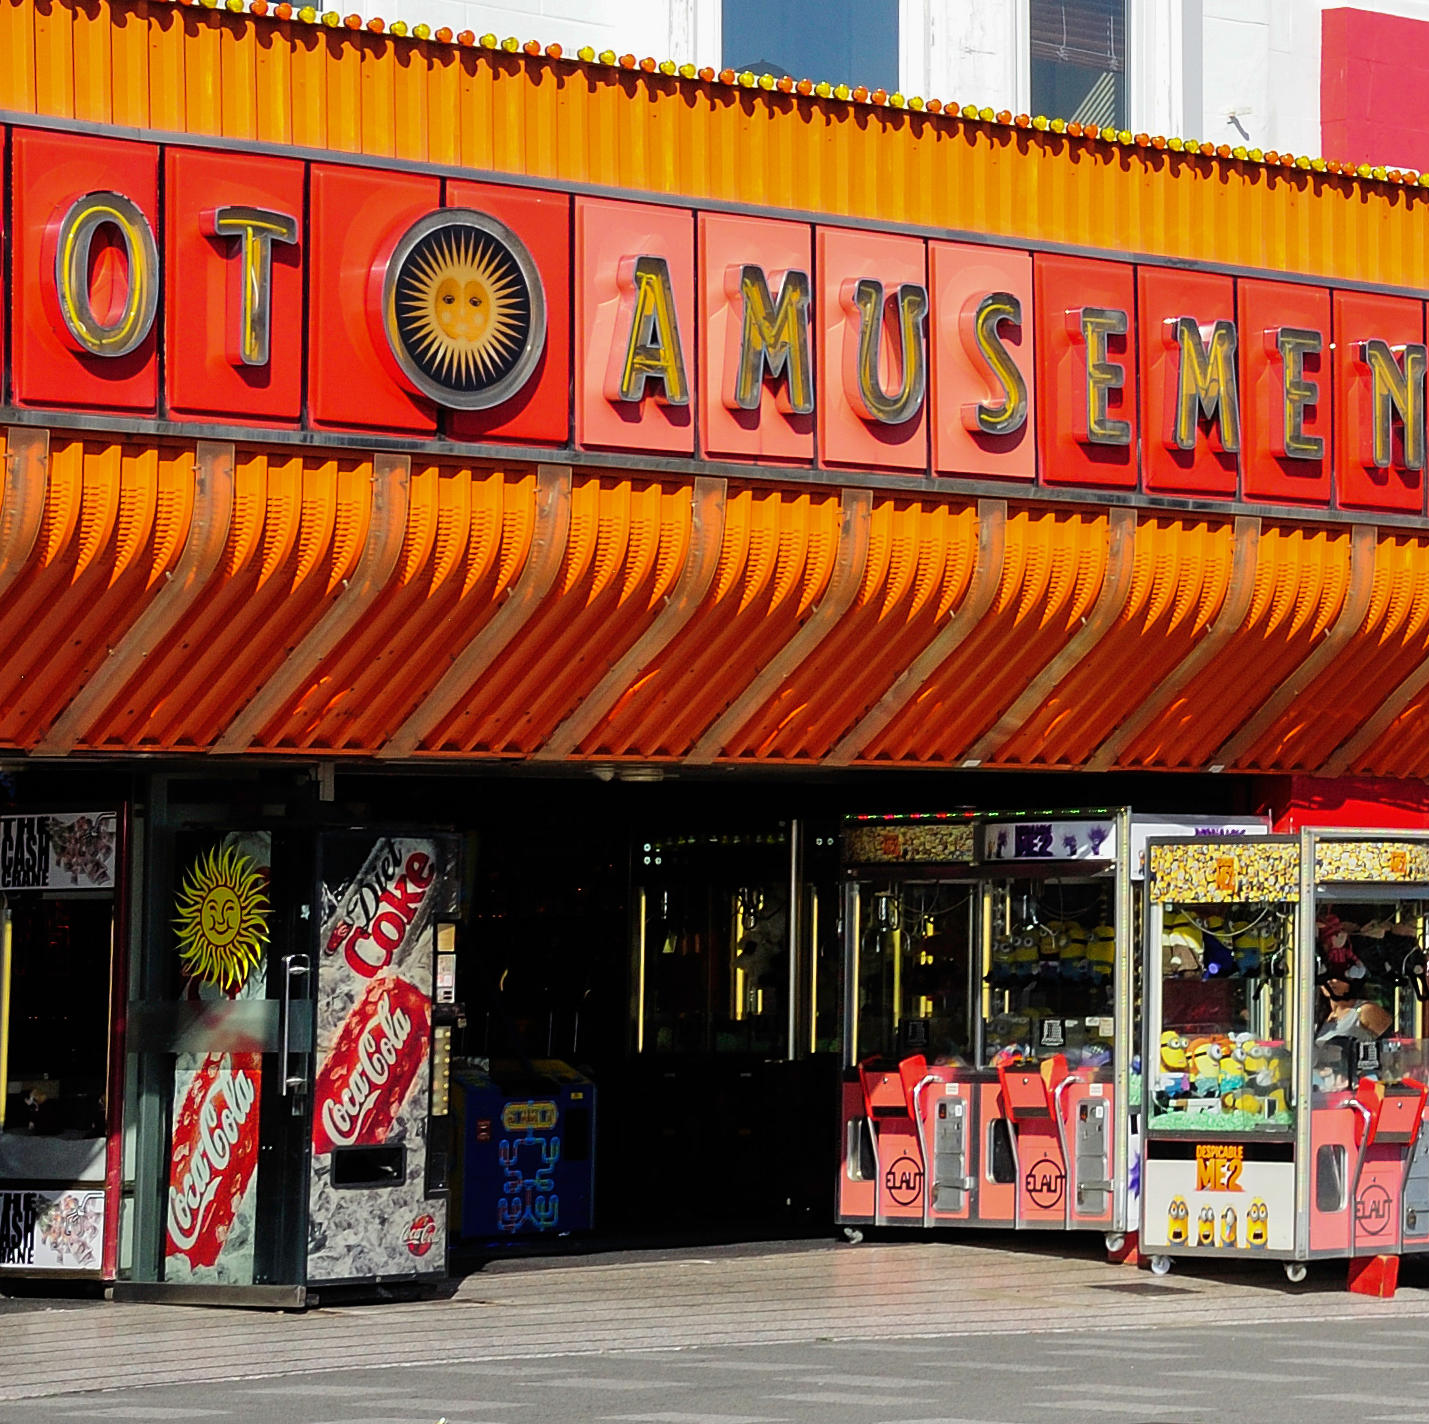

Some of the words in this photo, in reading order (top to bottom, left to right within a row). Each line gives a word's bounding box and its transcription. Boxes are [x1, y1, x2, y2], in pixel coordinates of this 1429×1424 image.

[56, 191, 298, 367] OT
[0, 817, 50, 838] THE
[1, 836, 50, 871] CASH
[345, 852, 436, 979] Coke
[1196, 1145, 1244, 1159] DESPICABLE
[886, 1172, 924, 1189] ELAUT
[1026, 1174, 1066, 1191] ELAUT
[1356, 1198, 1392, 1219] ELAUT
